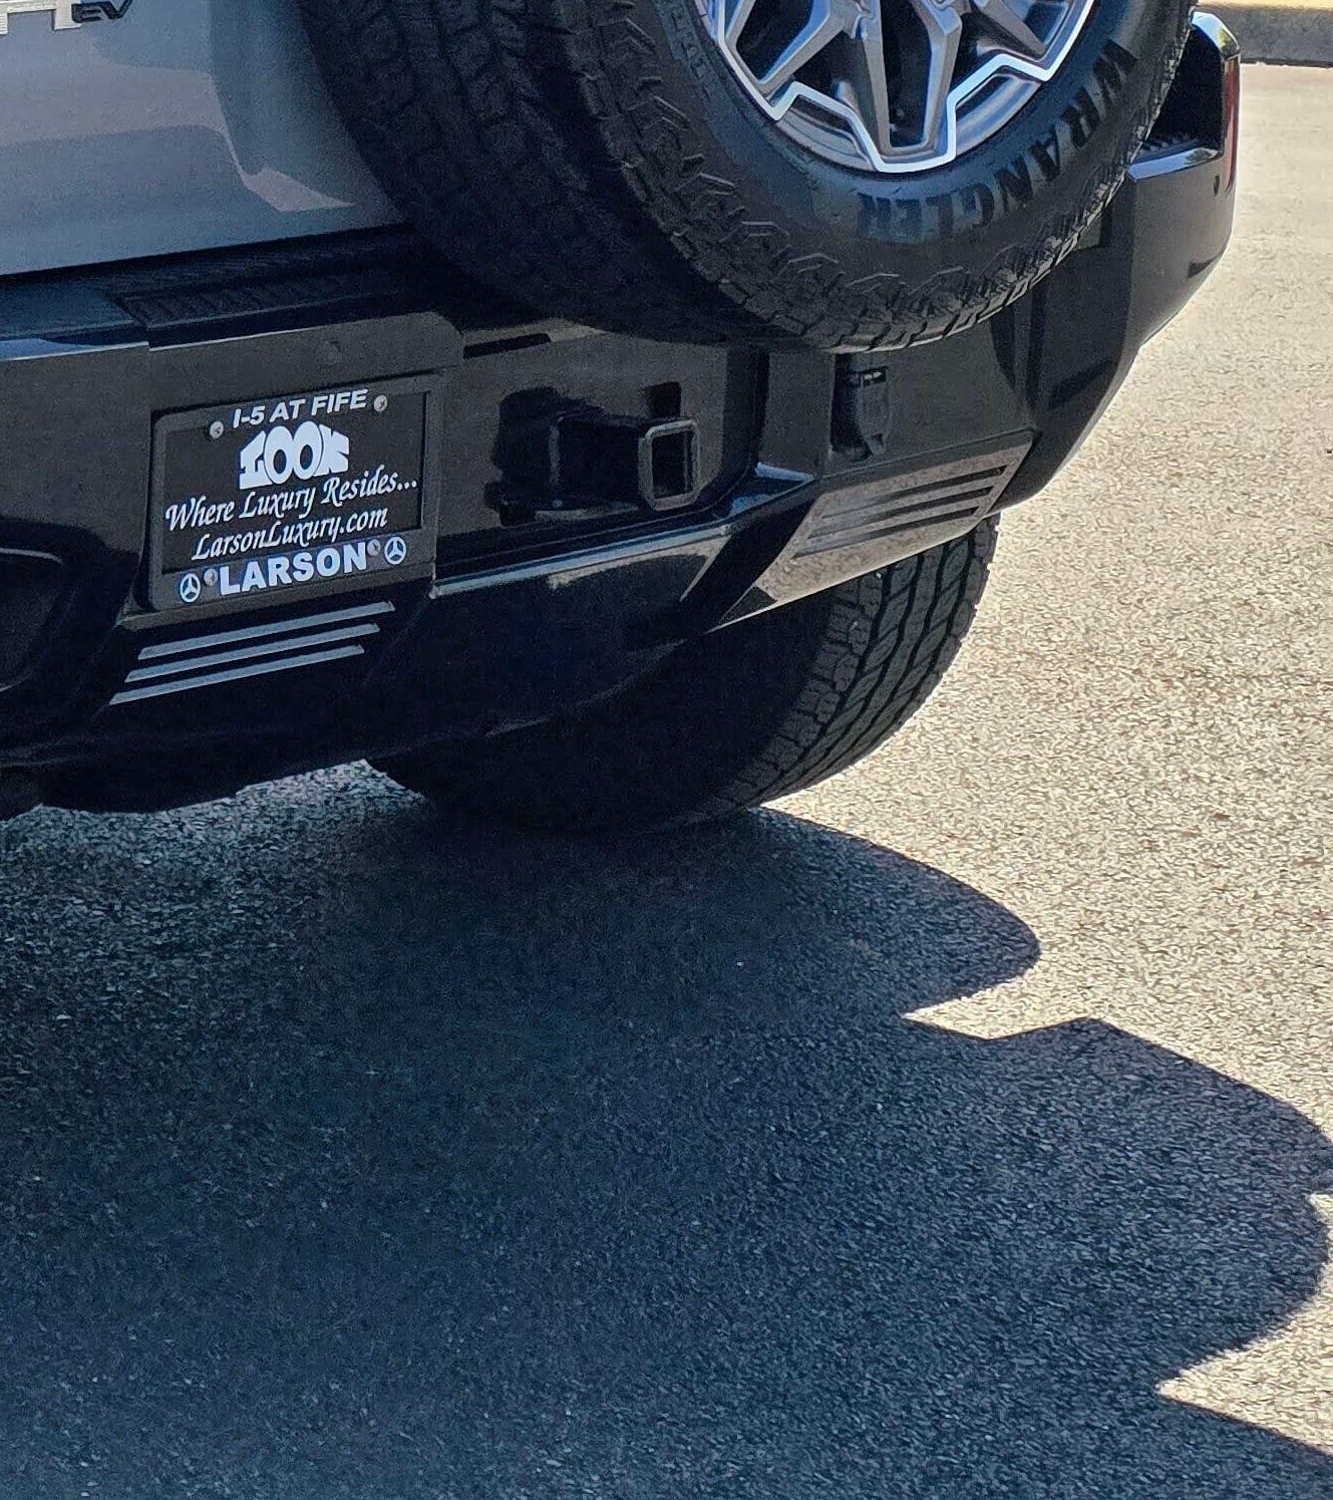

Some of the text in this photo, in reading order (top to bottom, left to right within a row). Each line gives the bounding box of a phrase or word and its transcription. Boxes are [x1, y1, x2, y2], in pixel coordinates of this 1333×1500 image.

[857, 37, 1137, 244] WRANGLER
[232, 388, 369, 429] I-5 AT FIFE
[238, 420, 350, 490] LOOK
[164, 464, 418, 532] Where Luxury Resides...
[190, 507, 389, 562] LarsonLuxury.com
[218, 541, 367, 596] LARSON
